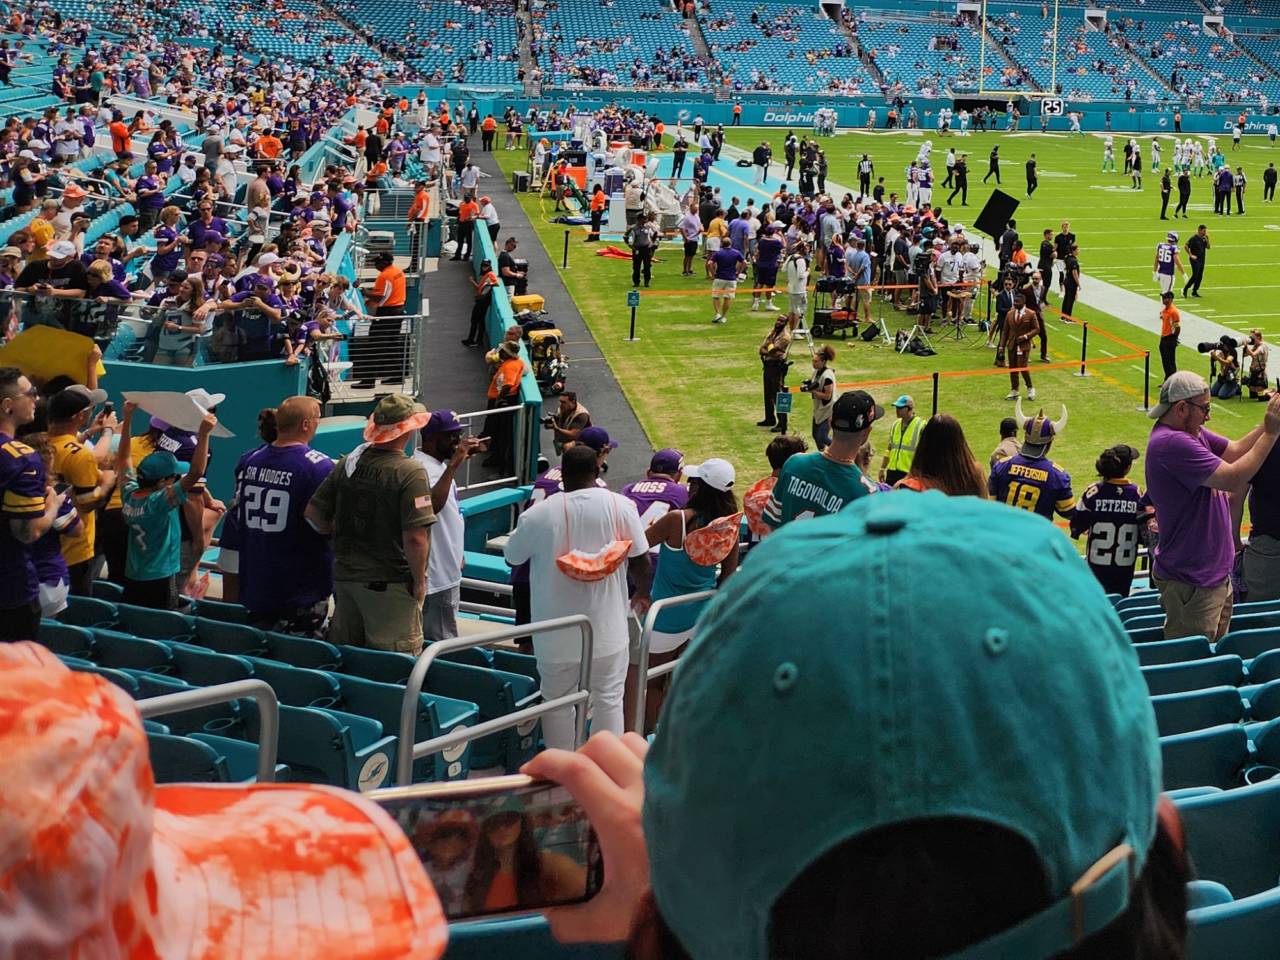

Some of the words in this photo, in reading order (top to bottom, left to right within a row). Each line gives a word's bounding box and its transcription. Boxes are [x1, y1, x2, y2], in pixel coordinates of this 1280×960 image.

[1044, 100, 1062, 113] 25
[245, 465, 256, 480] SIR
[258, 467, 293, 487] HODGES
[1008, 464, 1049, 482] JEFFERSON
[631, 481, 667, 493] MOSS
[787, 476, 844, 514] TAGOVAILOA
[1006, 481, 1041, 513] 18
[244, 485, 290, 533] 29
[1088, 522, 1139, 567] 28
